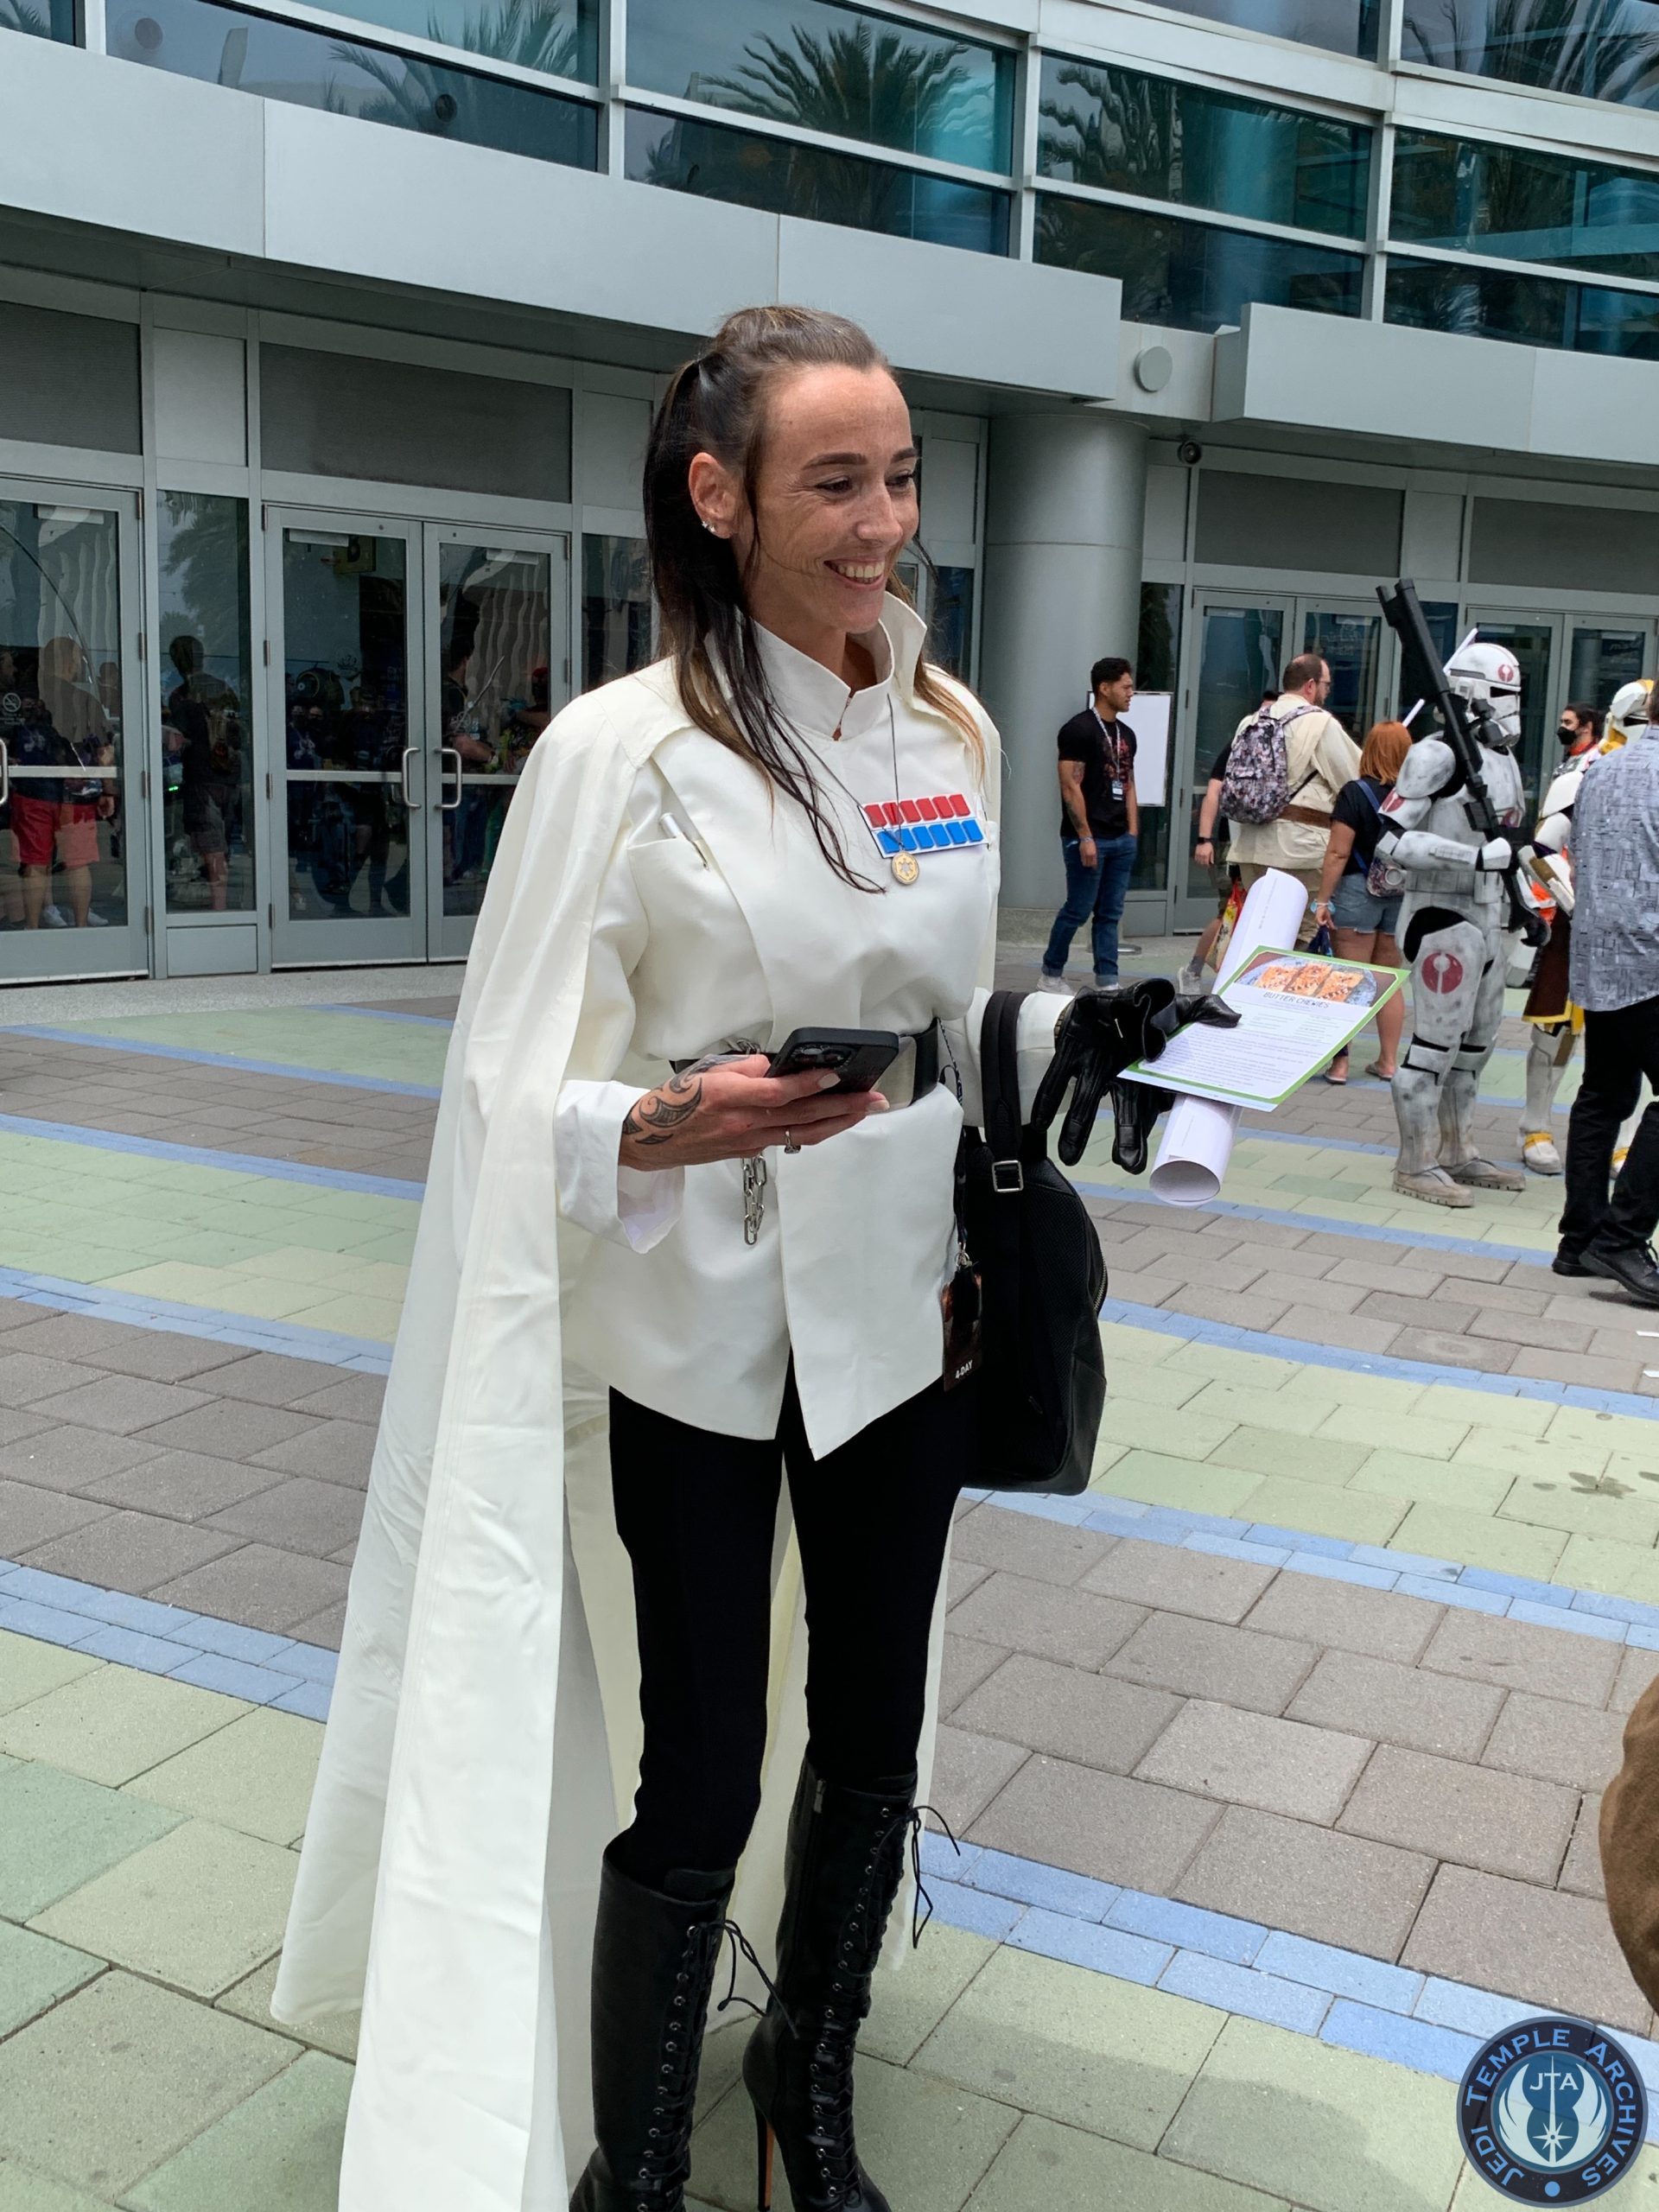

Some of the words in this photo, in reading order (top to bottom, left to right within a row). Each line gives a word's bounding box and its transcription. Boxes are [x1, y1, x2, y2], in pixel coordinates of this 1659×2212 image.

[1263, 992, 1295, 1002] BUTTER
[1296, 997, 1330, 1008] CHEWIES
[955, 1360, 973, 1379] 4-DAY
